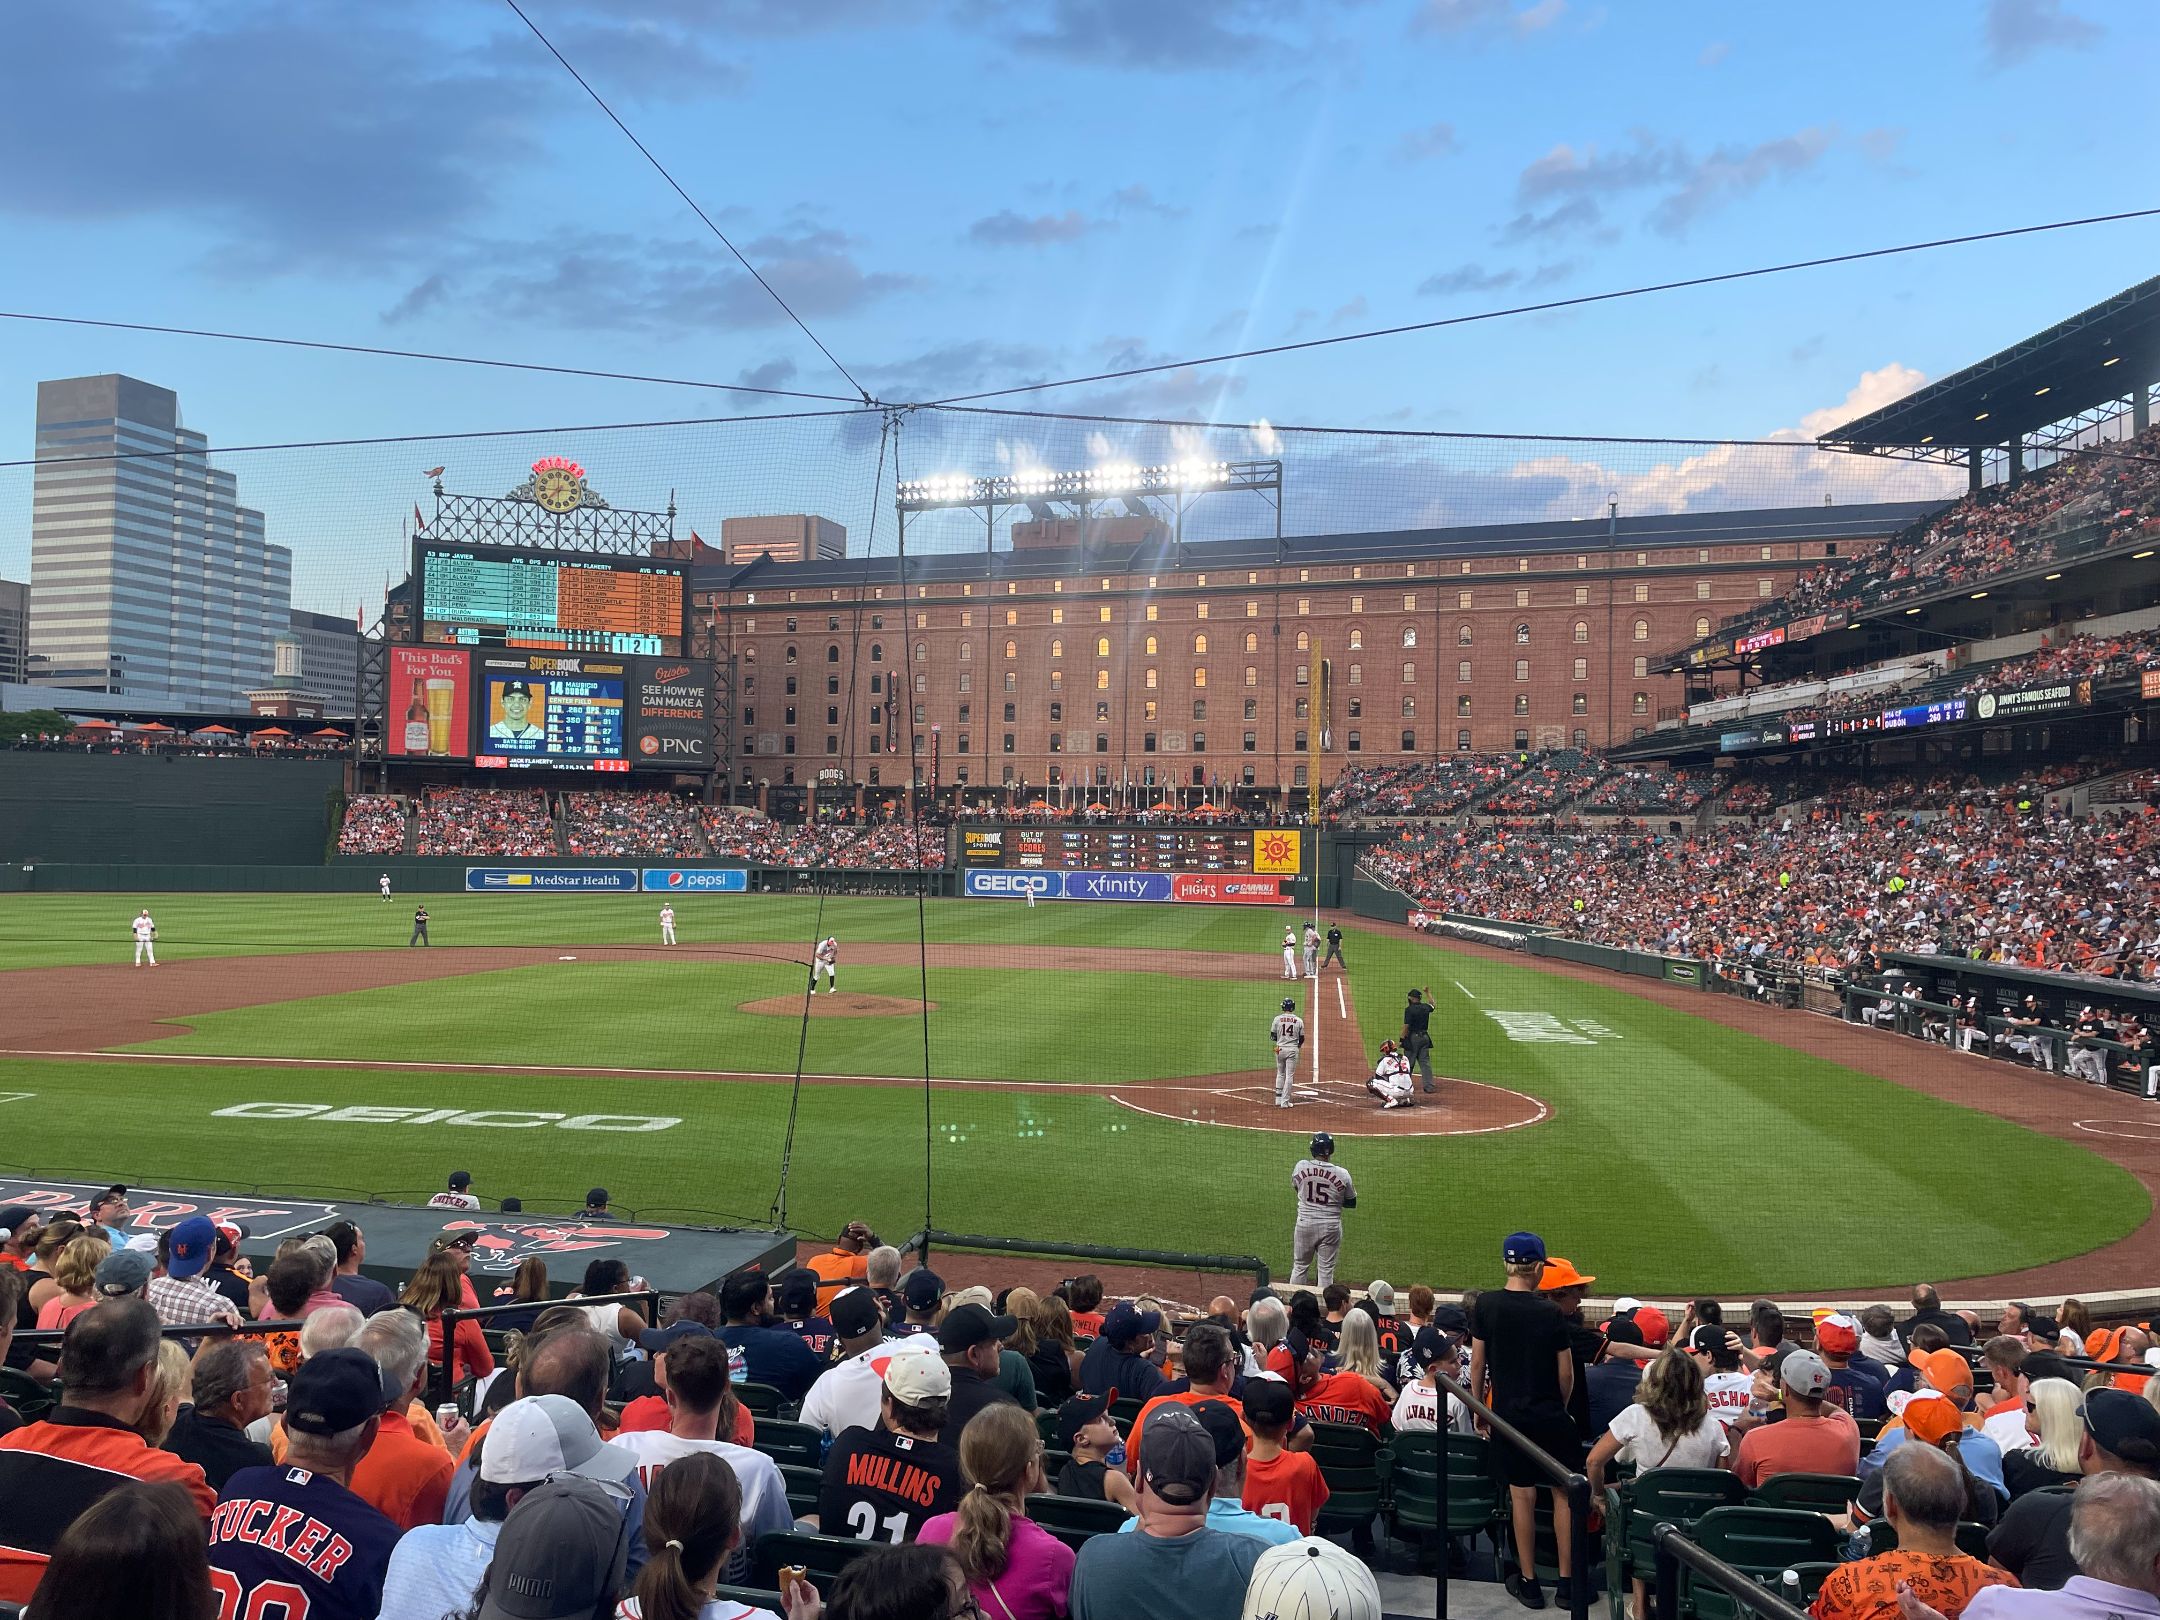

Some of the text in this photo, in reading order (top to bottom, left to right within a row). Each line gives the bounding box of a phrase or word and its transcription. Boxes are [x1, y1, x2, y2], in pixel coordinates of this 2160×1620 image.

[619, 639, 655, 654] 1 2 1
[398, 652, 462, 665] This Bud's
[530, 656, 581, 673] SUPERBOOK
[406, 665, 454, 676] For You.
[550, 681, 563, 695] 14
[642, 685, 704, 696] SEE HOW WE
[642, 697, 703, 708] CAN MAKE A
[1999, 686, 2070, 706] JIMMY'S FAMOUS SEAFOOD
[642, 708, 703, 719] DIFFERENCE
[1927, 710, 1964, 723] .260 5 27
[2012, 705, 2036, 714] SHIPPING
[1850, 716, 1880, 731] 1 2 1
[662, 738, 702, 754] PNC
[965, 832, 1002, 844] SUPERBOOK
[1018, 844, 1046, 853] SCORES
[534, 875, 620, 886] MedStar Health
[688, 873, 726, 888] pepsi
[974, 875, 1048, 892] GEICO
[1086, 875, 1148, 897] xfinity
[1182, 884, 1216, 897] HIGH'S
[1281, 1024, 1294, 1036] 14
[212, 1102, 684, 1132] GEICO
[1295, 1168, 1346, 1192] MALDONADO
[1307, 1181, 1329, 1205] 15
[846, 1453, 941, 1506] MULLINS
[209, 1499, 353, 1583] TUCKER
[508, 1572, 552, 1598] PUMA
